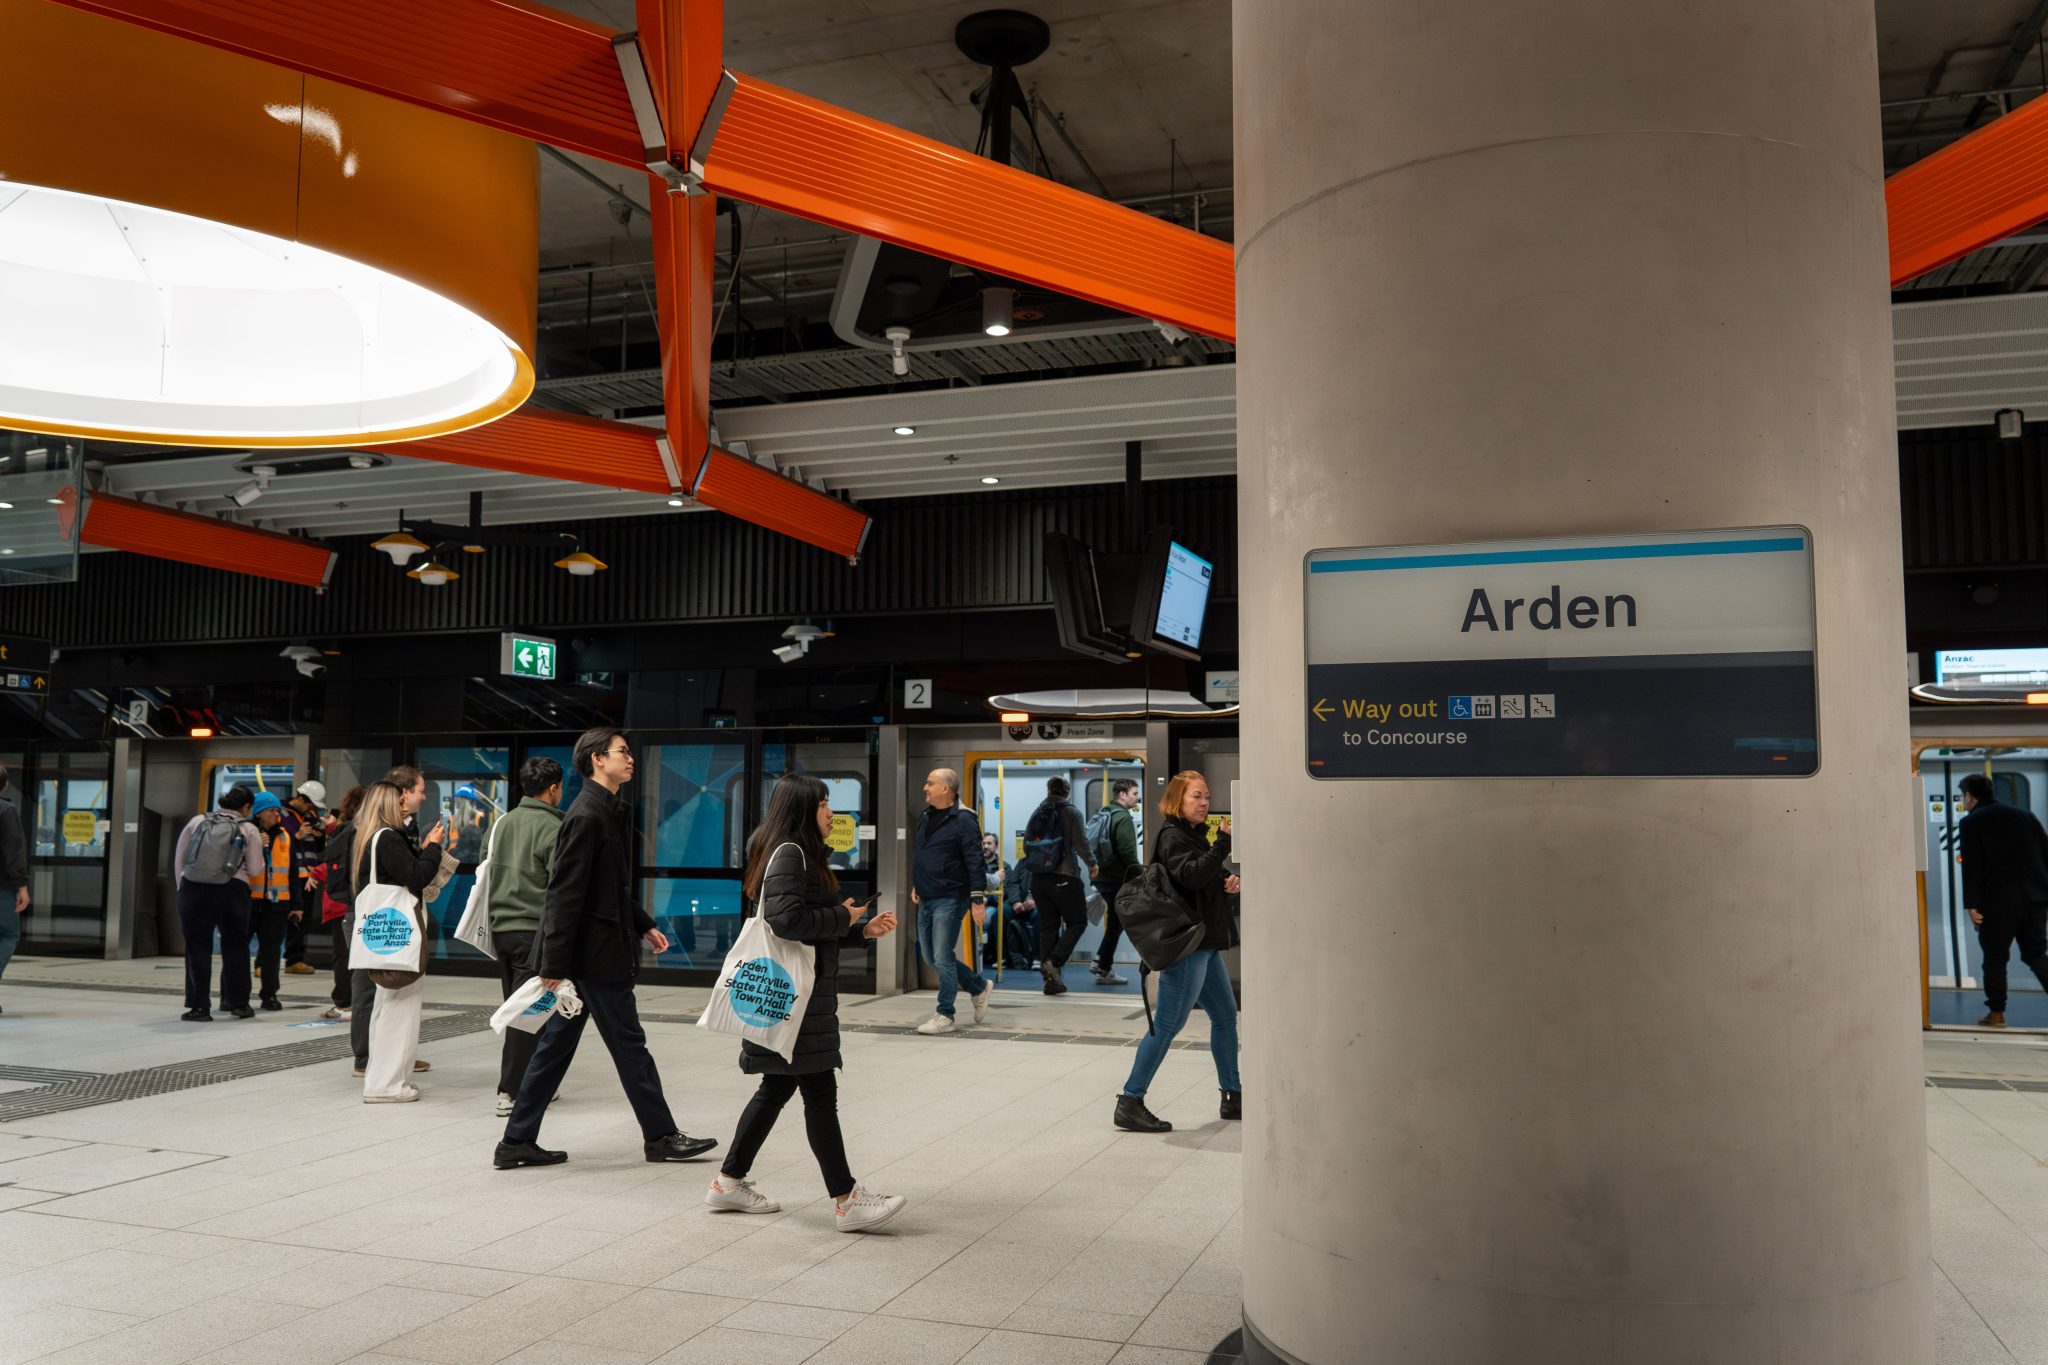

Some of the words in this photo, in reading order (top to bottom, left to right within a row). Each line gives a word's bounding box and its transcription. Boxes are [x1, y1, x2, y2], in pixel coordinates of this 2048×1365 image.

[1461, 585, 1637, 632] Arden
[912, 684, 924, 704] 2
[134, 703, 143, 721] 2
[1342, 699, 1392, 724] Way
[1399, 699, 1438, 718] out
[1067, 728, 1086, 736] Pram
[1343, 731, 1362, 746] to
[1367, 729, 1468, 745] Concourse
[362, 912, 387, 920] Arden
[368, 919, 407, 927] Parkville
[357, 927, 381, 935] State
[382, 926, 414, 934] Library
[734, 960, 768, 973] Arden
[740, 970, 790, 989] Parkville
[724, 978, 756, 991] State
[756, 984, 799, 1004] Library
[530, 1003, 552, 1013] nzac
[735, 990, 763, 1005] Town
[763, 996, 787, 1010] Hall
[754, 1005, 791, 1021] Anzac
